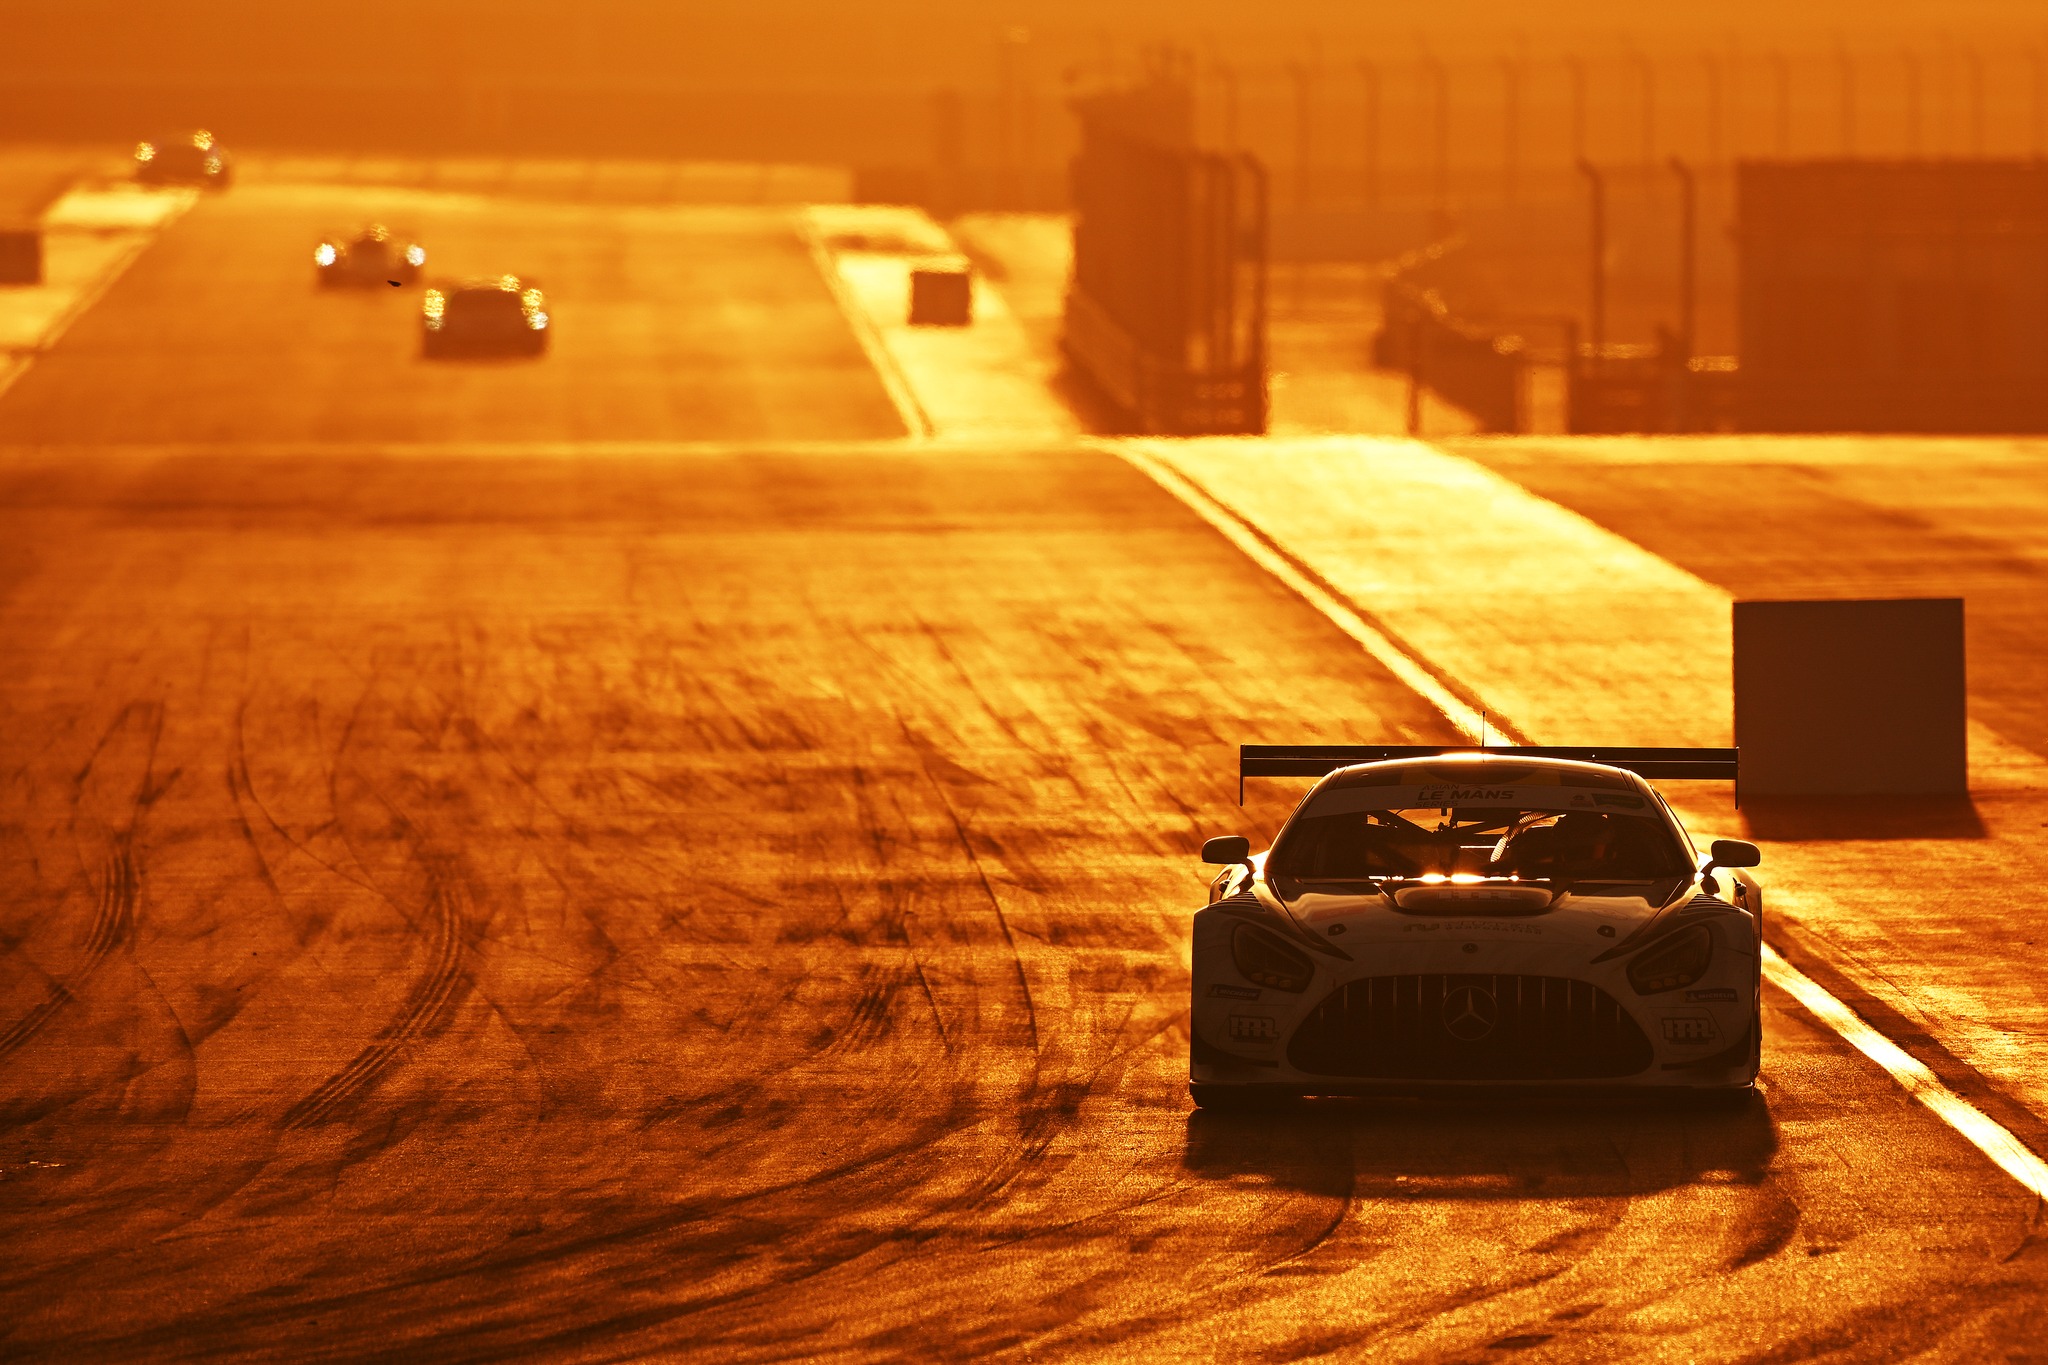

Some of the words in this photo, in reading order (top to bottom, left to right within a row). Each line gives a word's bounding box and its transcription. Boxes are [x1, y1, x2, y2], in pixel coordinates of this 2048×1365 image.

[1417, 790, 1445, 801] LE
[1449, 789, 1515, 800] MANS
[1415, 800, 1460, 808] SERIES
[1697, 992, 1736, 1000] MICHELIN
